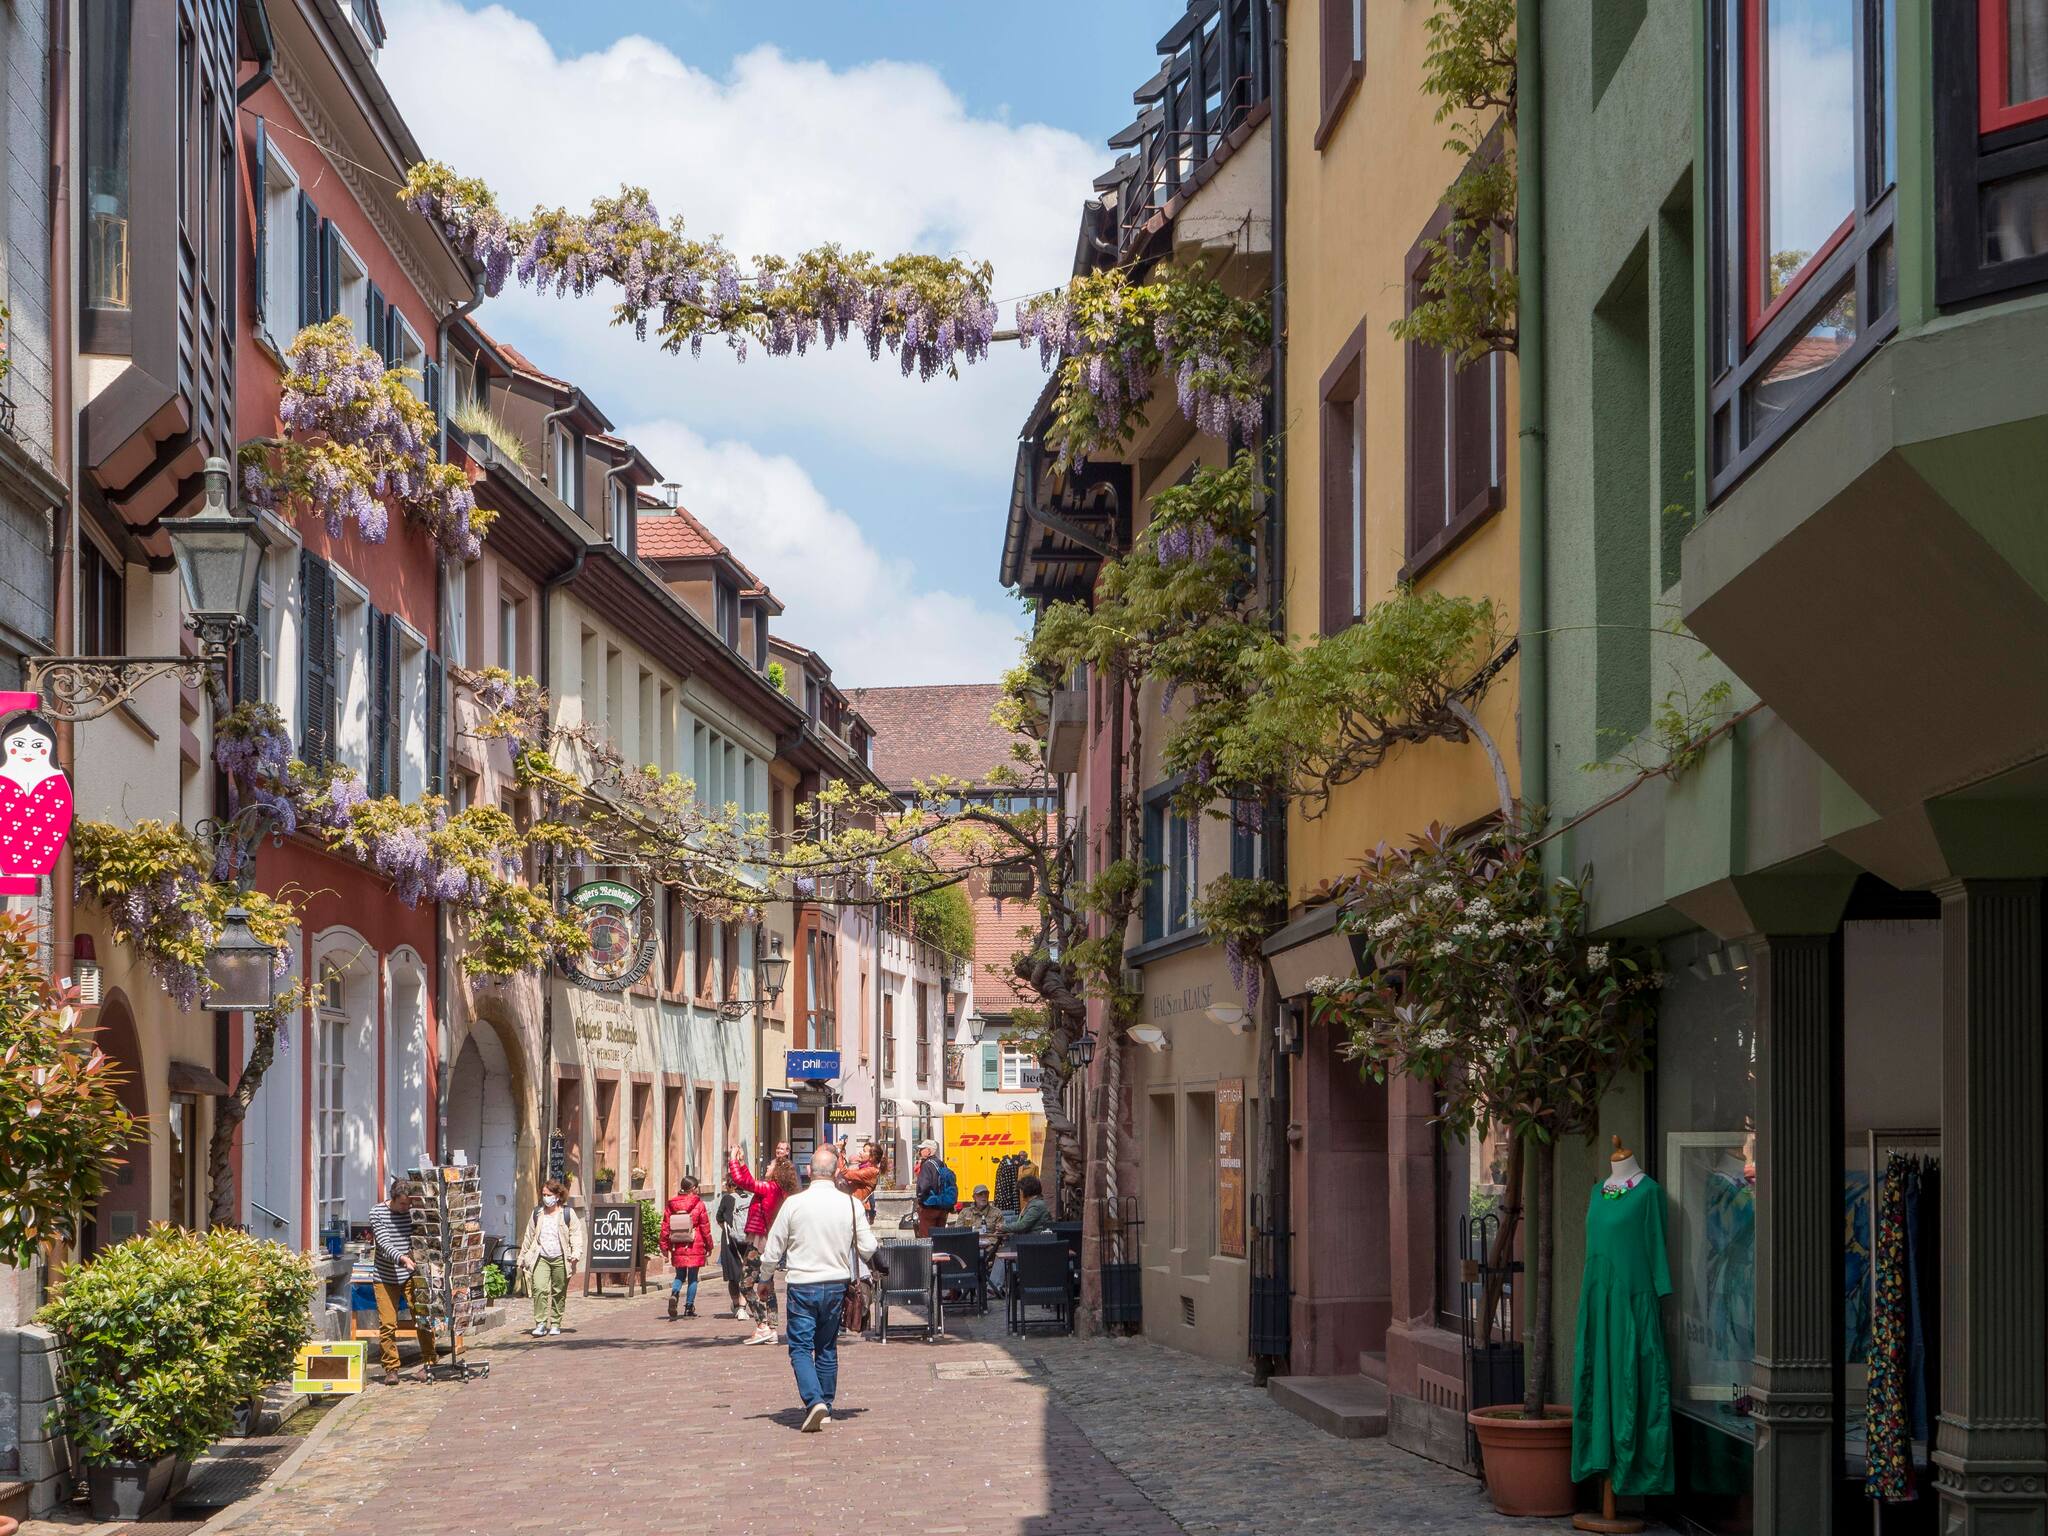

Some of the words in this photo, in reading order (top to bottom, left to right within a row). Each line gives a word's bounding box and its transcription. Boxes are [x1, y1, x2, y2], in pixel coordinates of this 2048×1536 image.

[802, 1059, 839, 1071] philoro
[829, 1109, 856, 1119] MIRJAM
[959, 1133, 1016, 1147] DHL
[594, 1220, 633, 1236] LÖWEN
[593, 1239, 633, 1252] GRUBE
